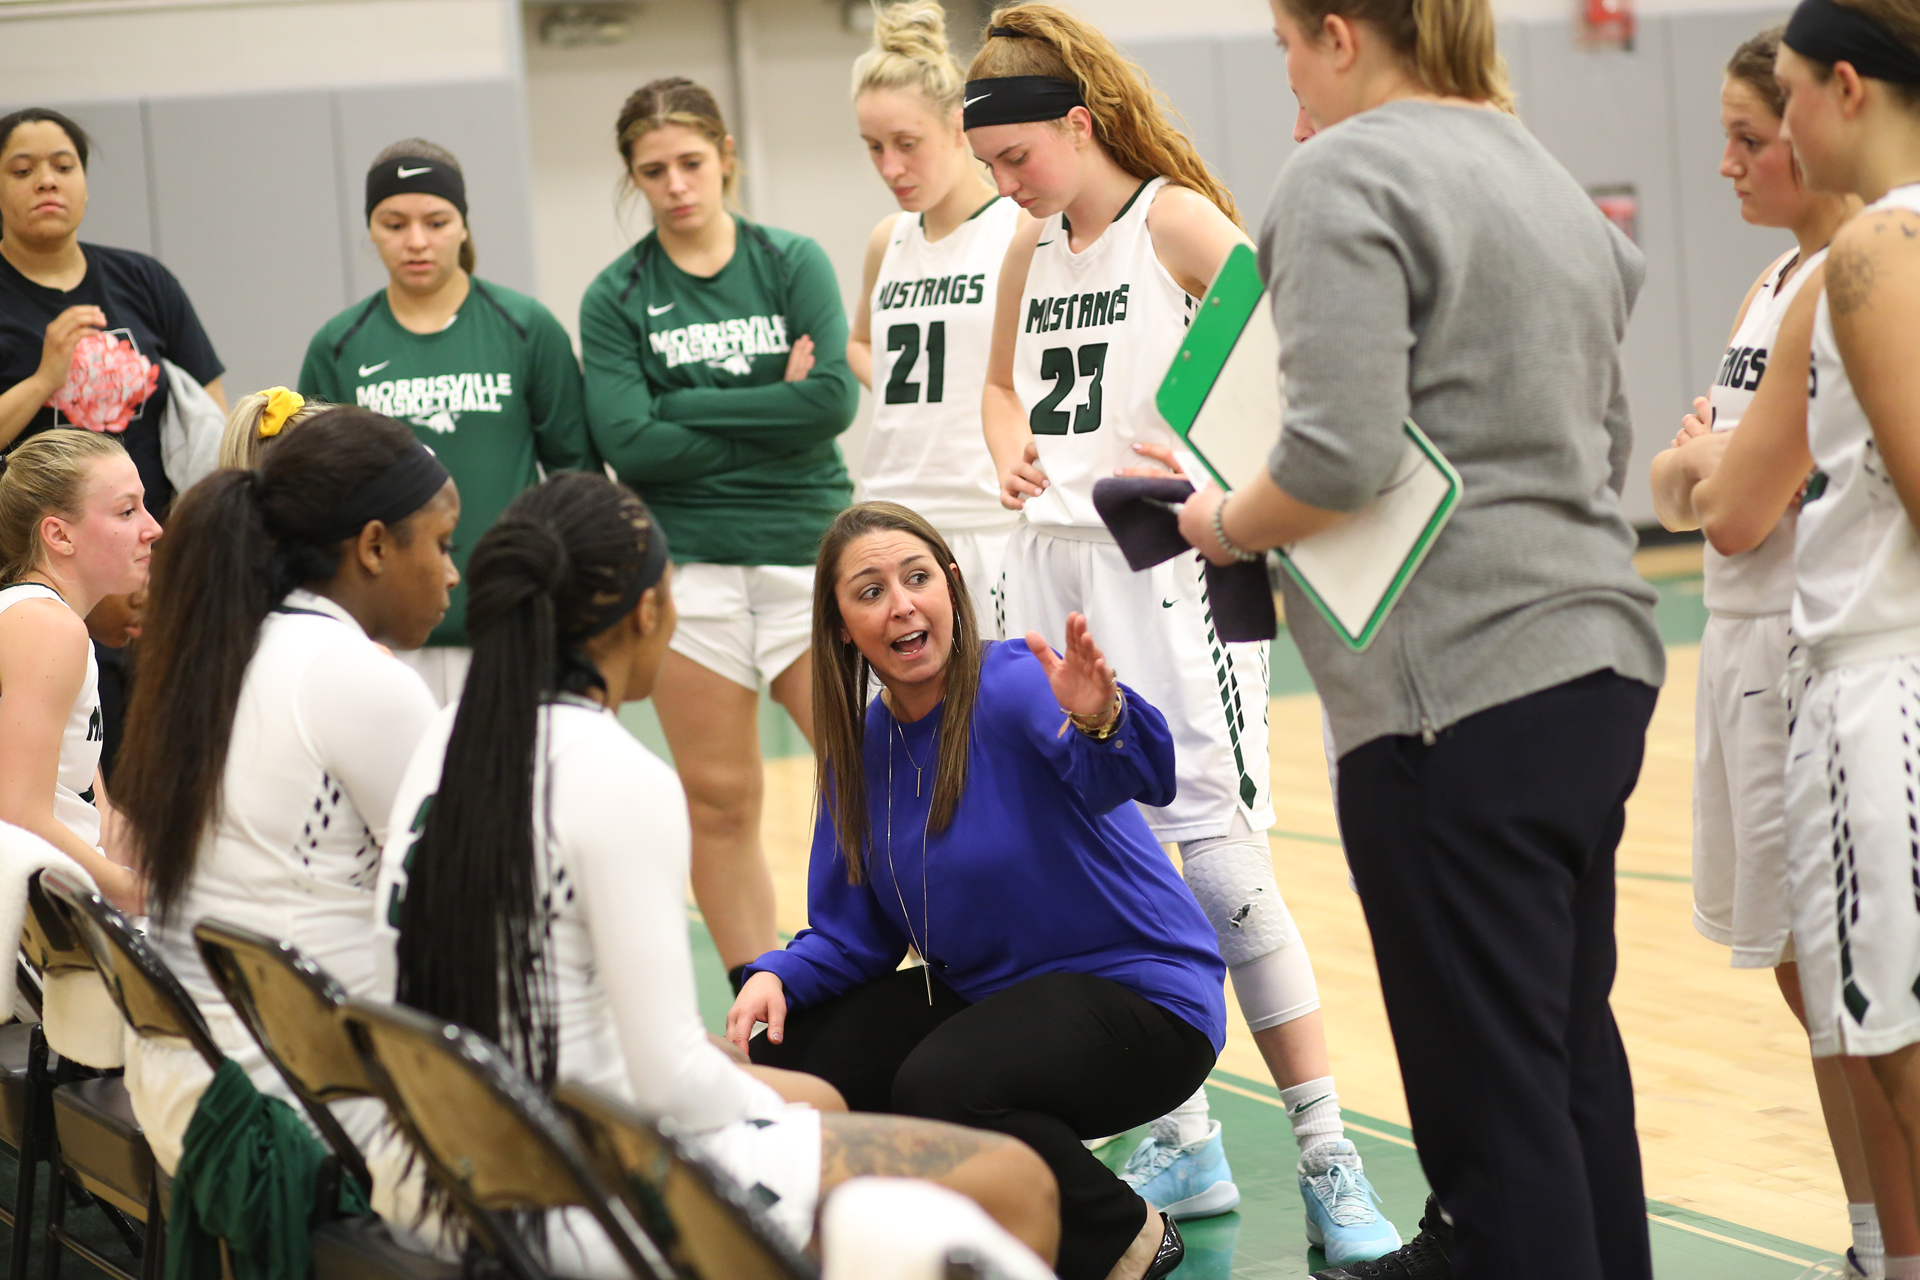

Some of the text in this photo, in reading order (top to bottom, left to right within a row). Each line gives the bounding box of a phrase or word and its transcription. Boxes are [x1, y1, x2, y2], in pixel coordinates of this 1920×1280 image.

[356, 373, 512, 408] MORRISVILLE
[885, 320, 945, 405] 21
[1029, 342, 1109, 436] 23
